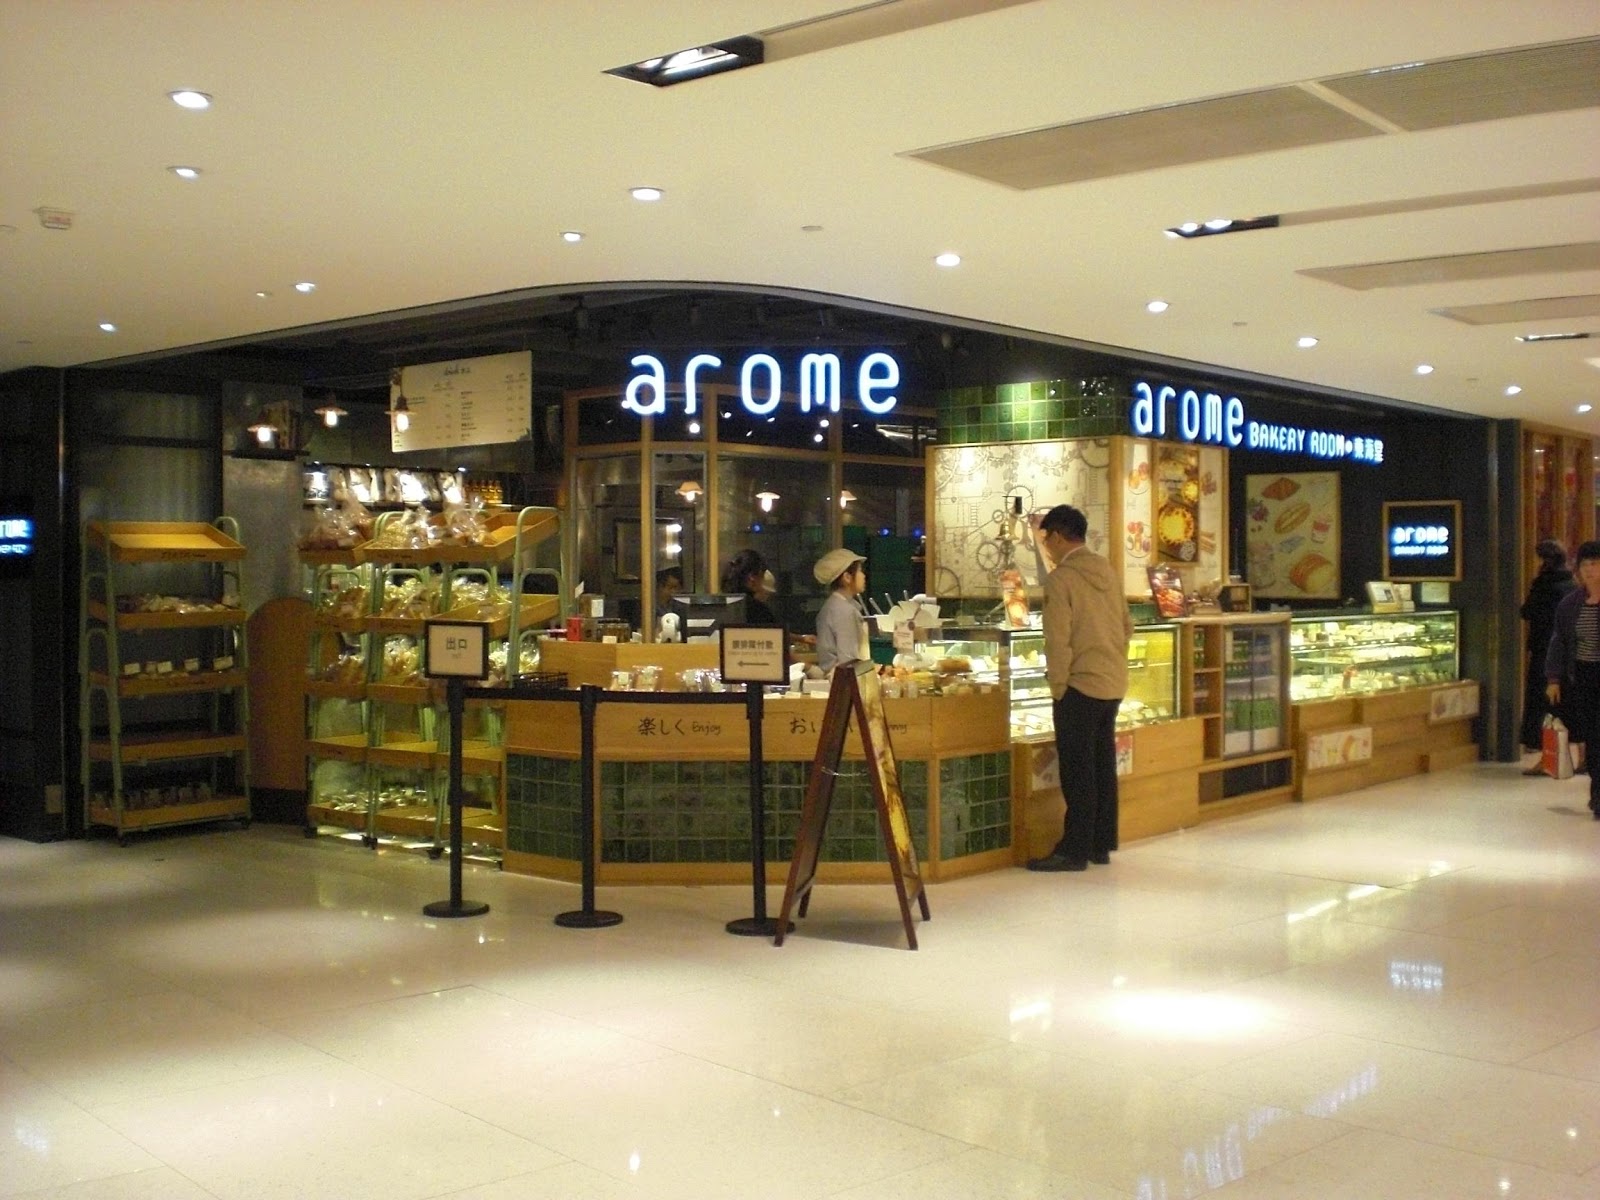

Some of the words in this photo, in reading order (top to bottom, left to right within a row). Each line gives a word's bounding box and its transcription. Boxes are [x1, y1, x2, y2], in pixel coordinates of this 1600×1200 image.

[624, 352, 900, 415] arome
[1134, 381, 1244, 447] arome
[1249, 421, 1306, 452] BAKERY
[1311, 431, 1345, 457] ROOM
[1393, 526, 1449, 544] arome
[446, 636, 467, 650] 出口
[638, 718, 686, 736] 楽しく
[692, 720, 721, 736] Enjoy
